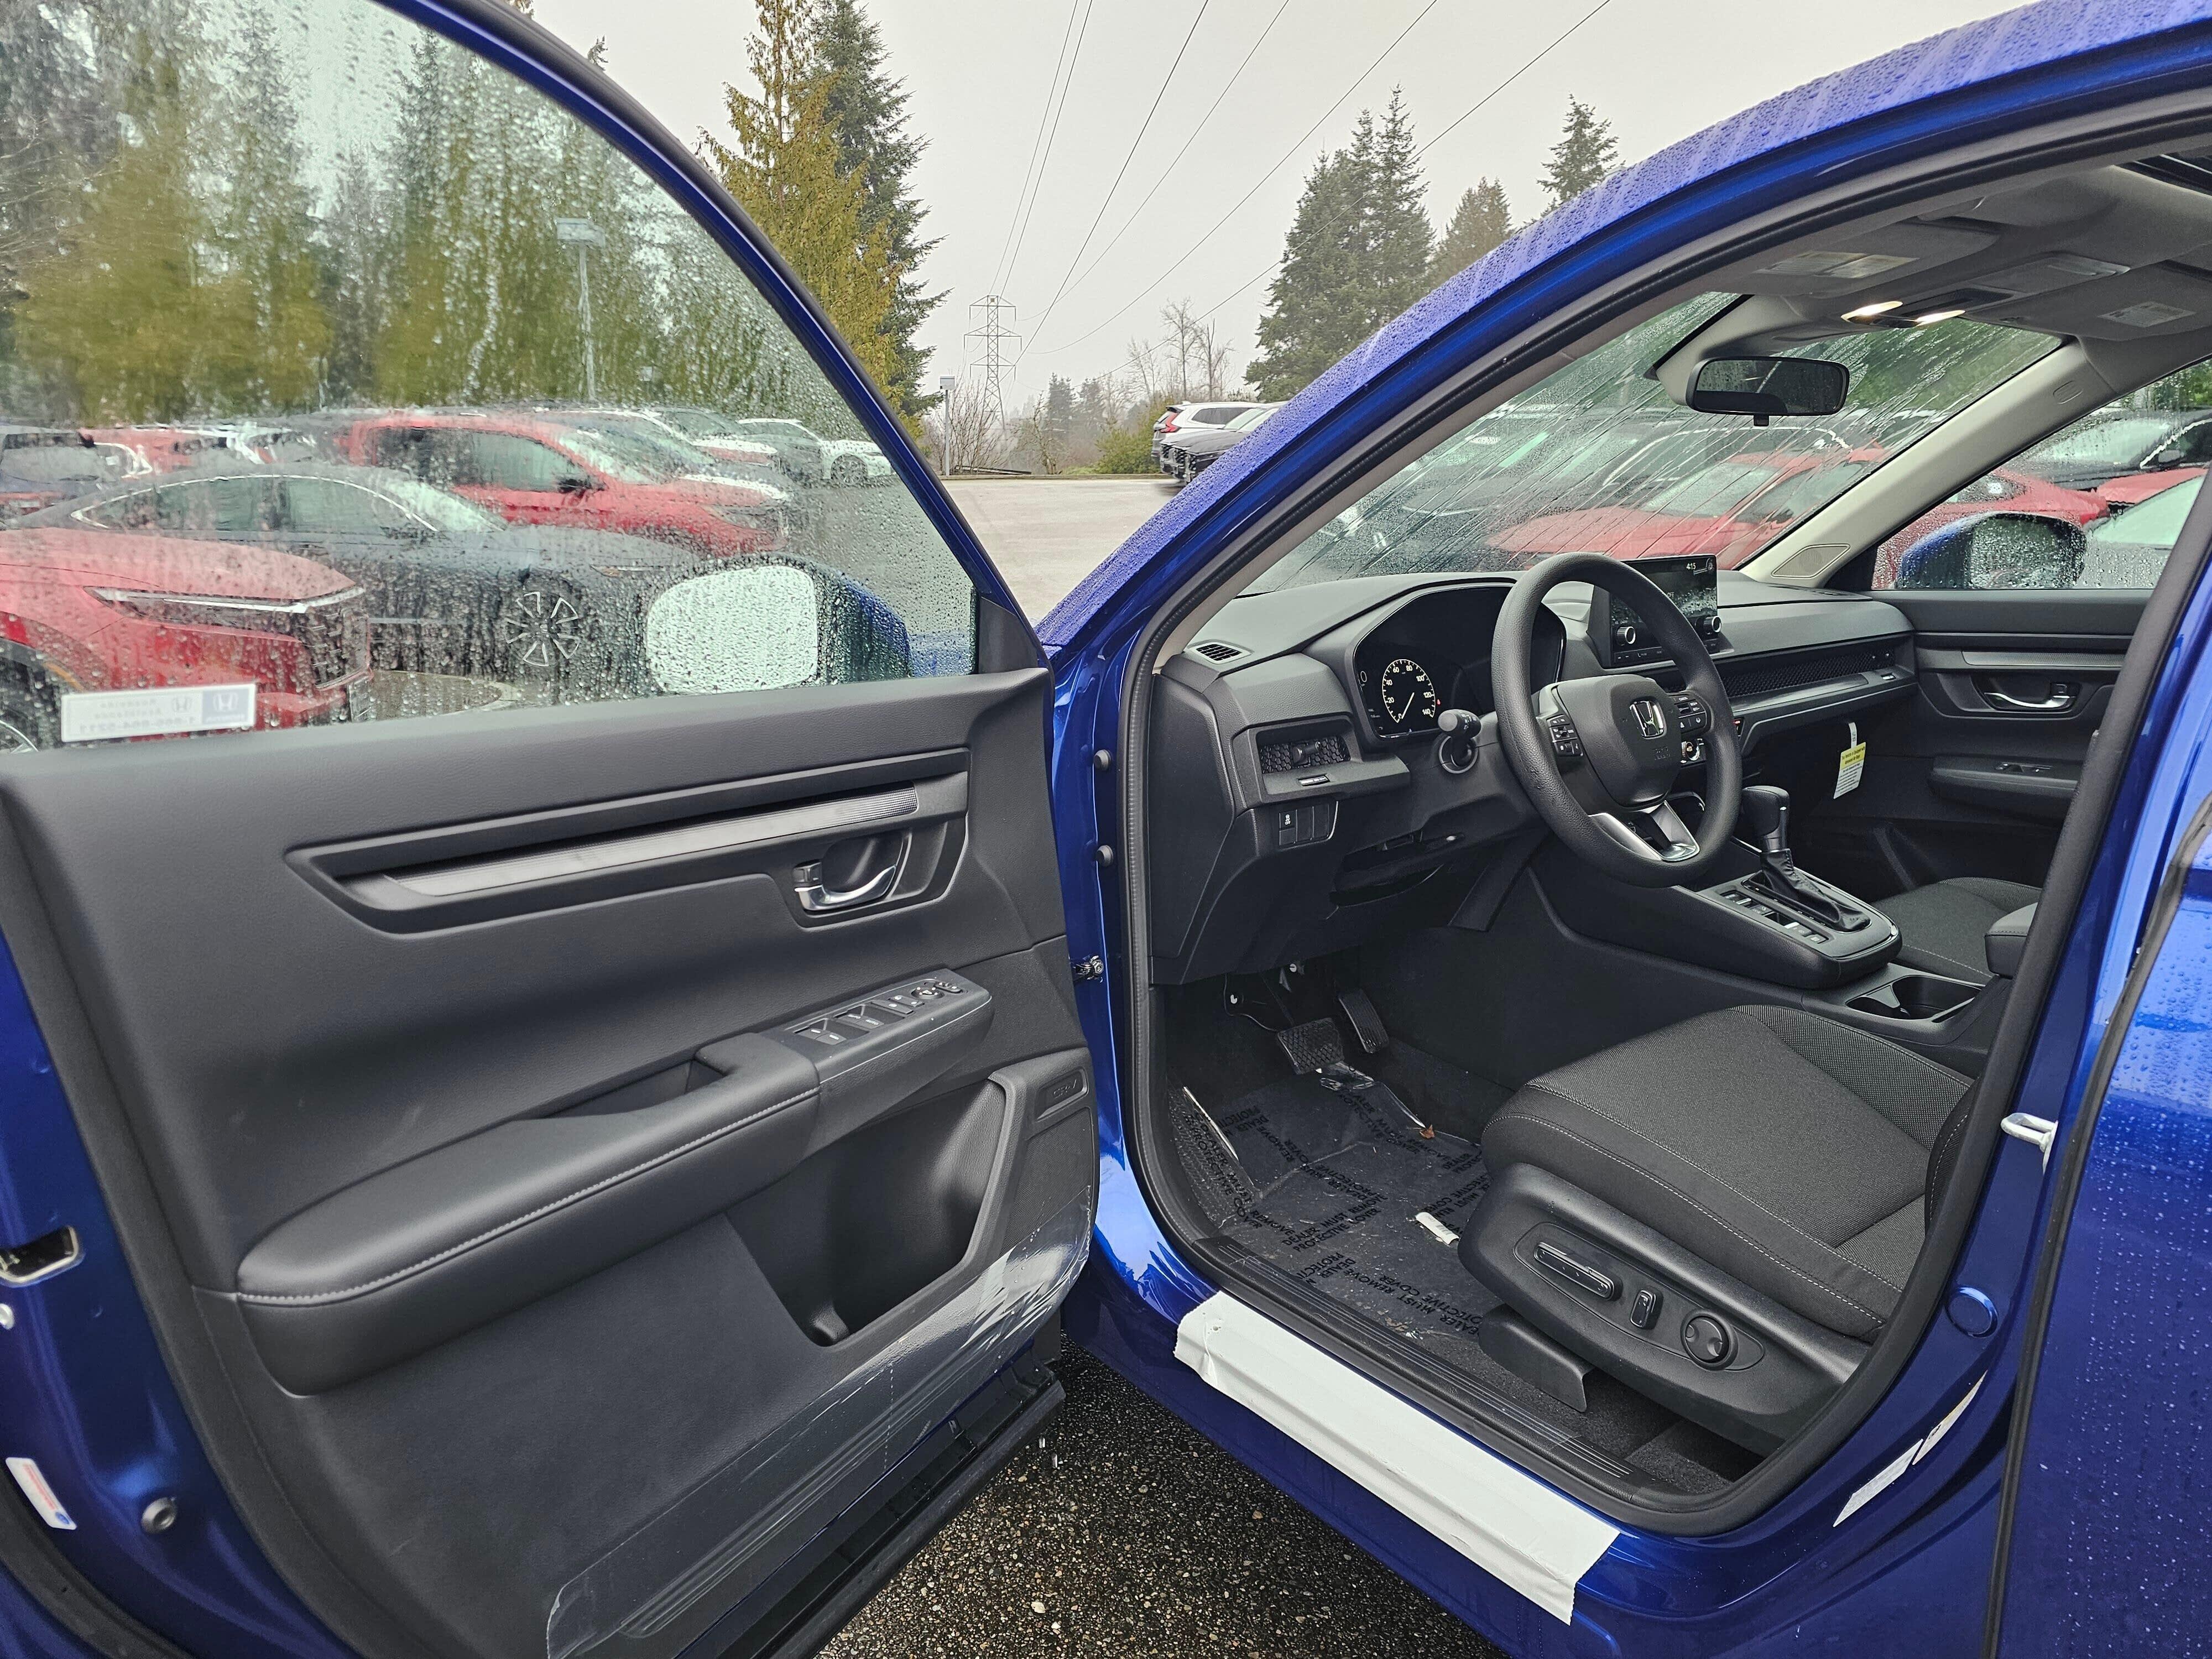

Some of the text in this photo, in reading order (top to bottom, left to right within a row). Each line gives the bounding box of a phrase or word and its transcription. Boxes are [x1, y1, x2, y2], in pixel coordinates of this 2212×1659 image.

[1284, 1138, 1377, 1197] PROTECTIVE OVER
[1301, 1165, 1326, 1180] MUS
[1328, 1179, 1368, 1201] DEALER
[1233, 1197, 1263, 1229] COVER
[1251, 1209, 1296, 1236] REMOVE
[1281, 1194, 1388, 1245] DEALER MUST REMOVE
[1293, 1208, 1381, 1252] PROTECTIVE COVER
[1318, 1258, 1356, 1278] DEALER
[1380, 1275, 1420, 1296] COVER
[1343, 1269, 1480, 1336] EALER MUST REMOVE
